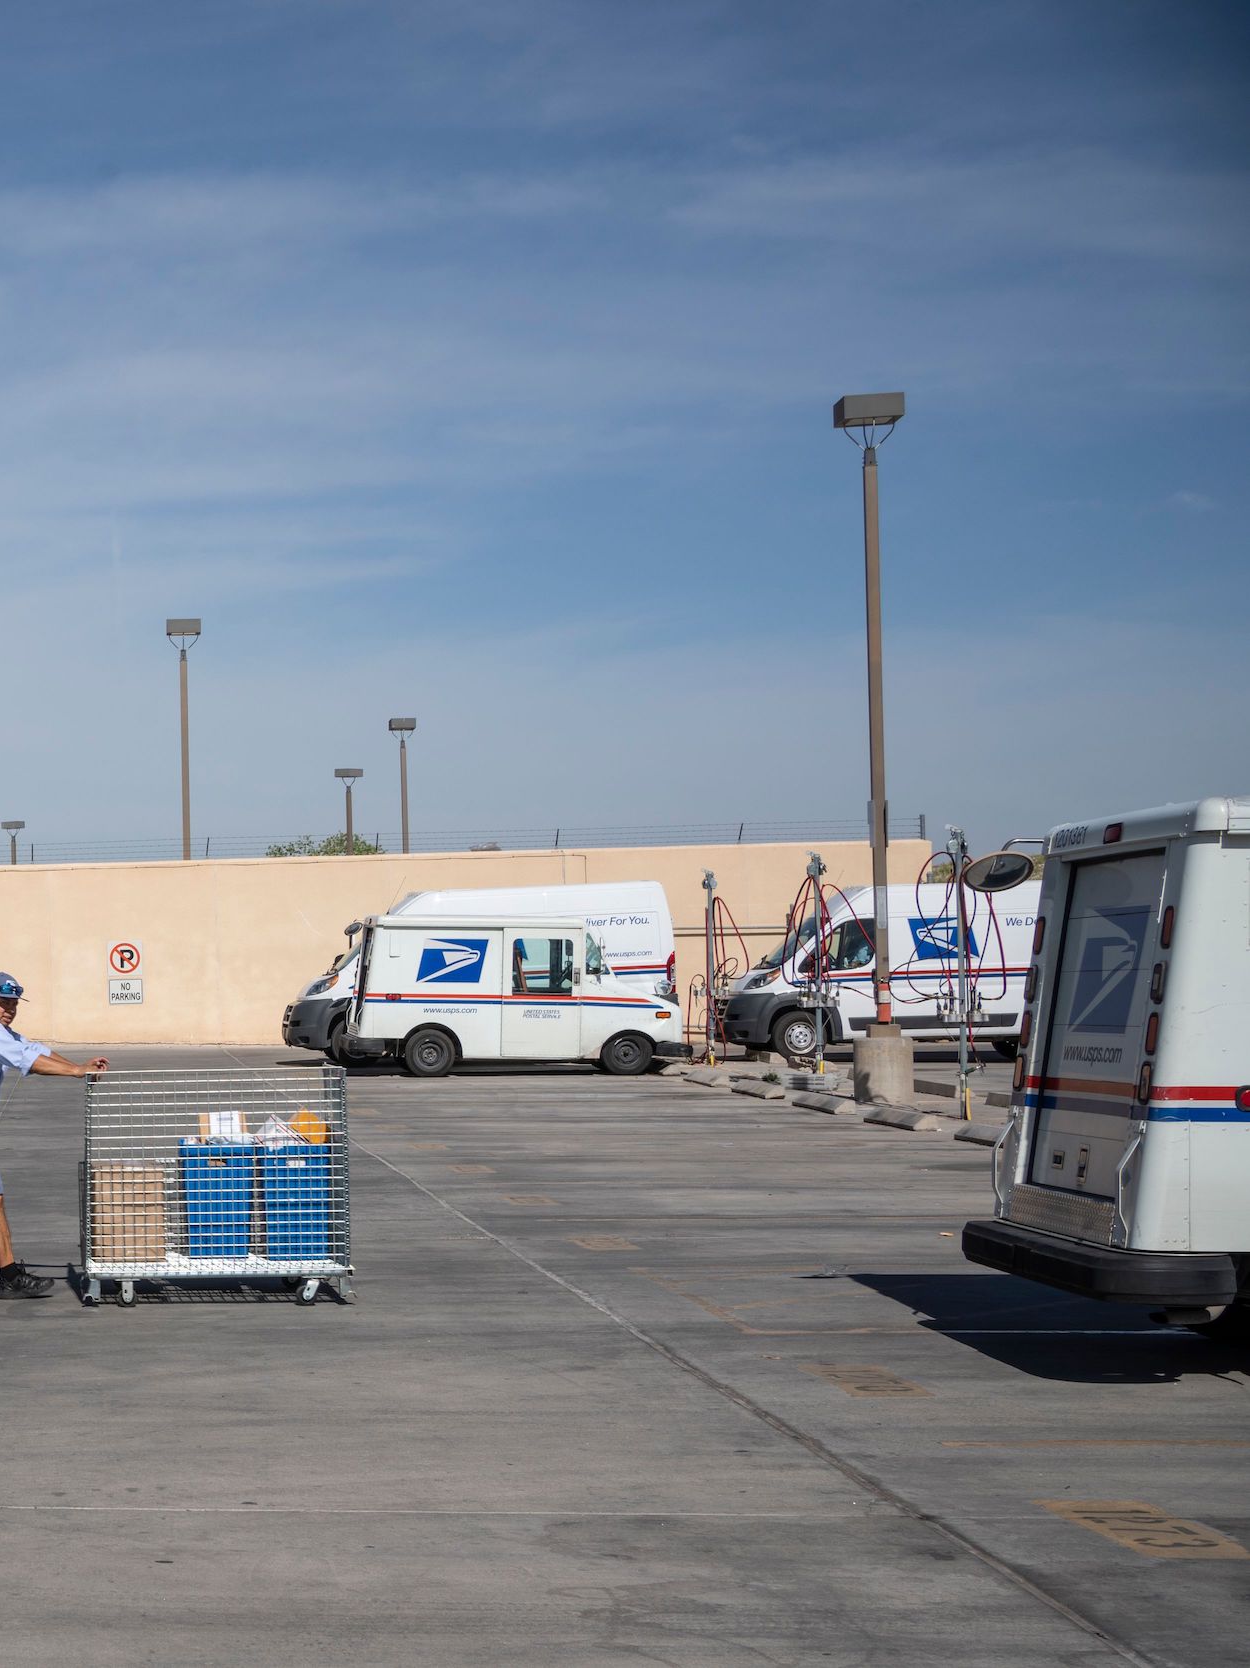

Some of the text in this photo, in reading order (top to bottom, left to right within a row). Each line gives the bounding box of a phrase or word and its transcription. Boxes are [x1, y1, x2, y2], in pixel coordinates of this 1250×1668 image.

[610, 916, 627, 926] For
[629, 915, 650, 925] You.
[1005, 917, 1023, 926] We
[120, 982, 131, 991] NO
[111, 992, 141, 1001] PARKING
[423, 1007, 478, 1015] www.usps.com
[1063, 1044, 1124, 1067] www.usps.com
